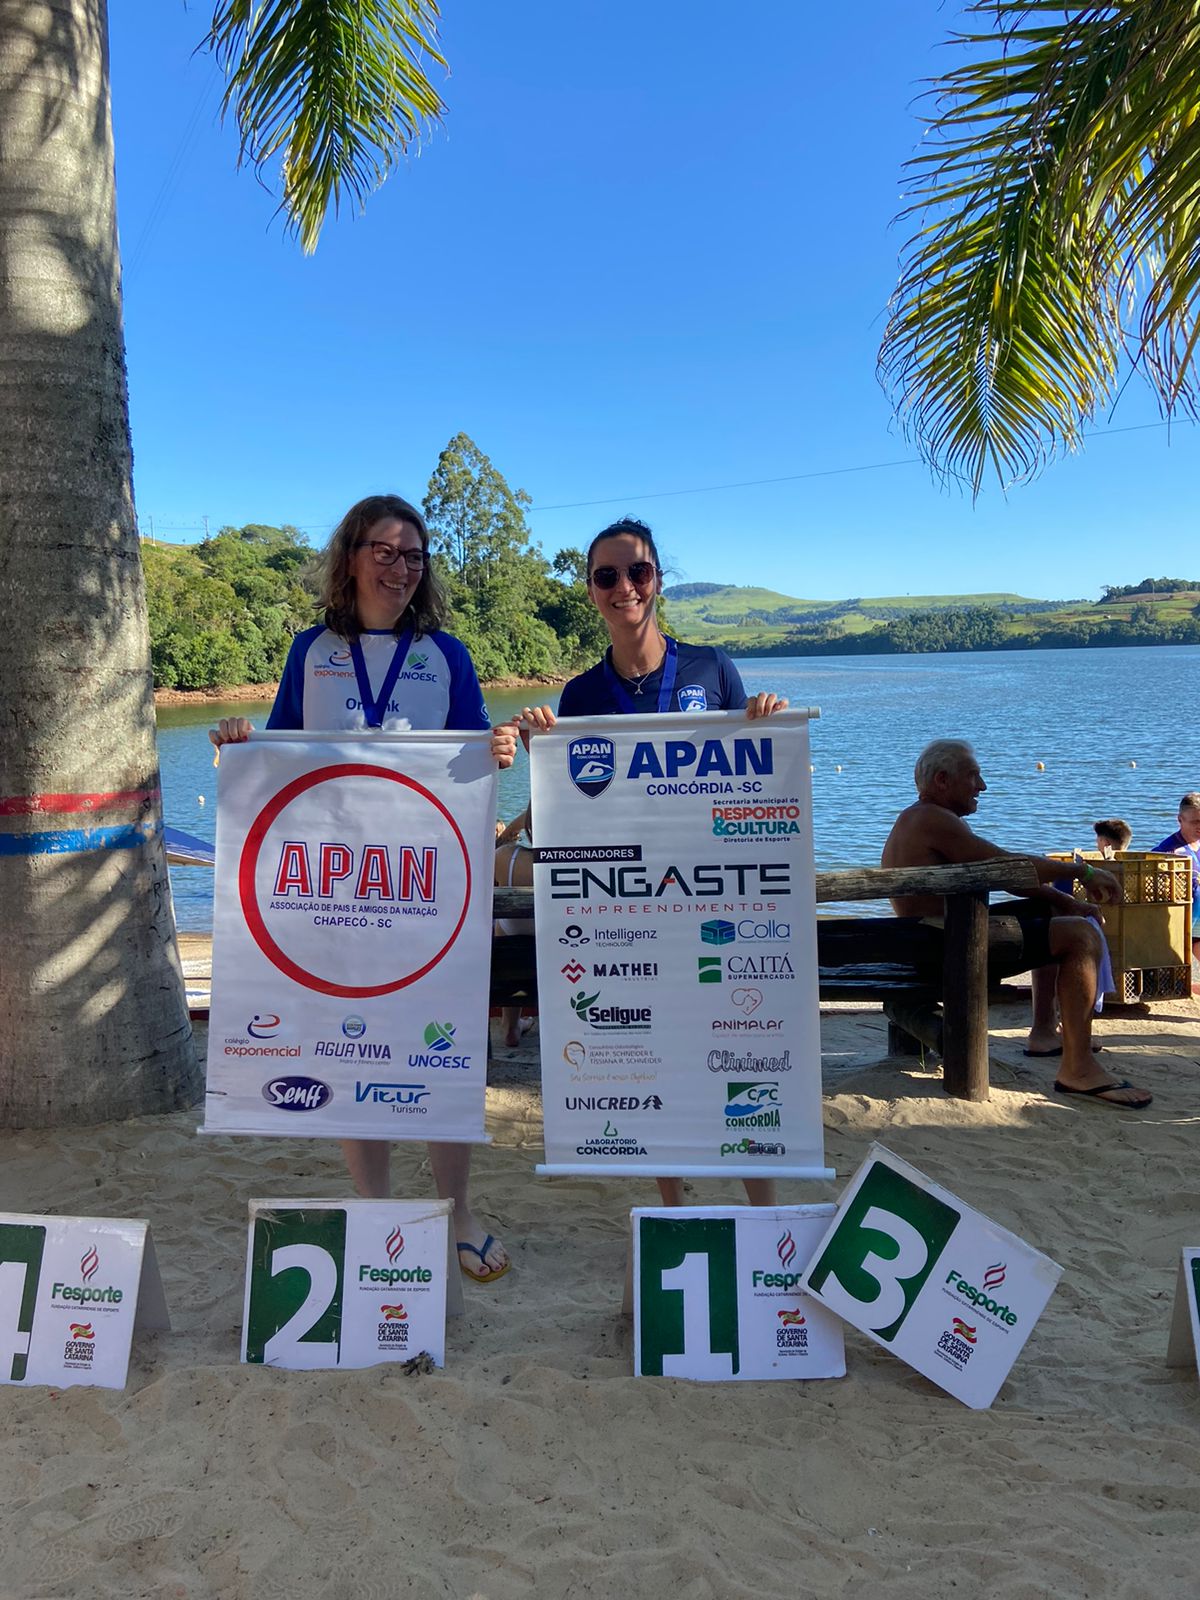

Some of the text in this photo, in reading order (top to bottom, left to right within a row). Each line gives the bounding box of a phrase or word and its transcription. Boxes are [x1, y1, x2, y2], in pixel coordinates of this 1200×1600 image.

[681, 688, 704, 698] APAN
[572, 743, 612, 755] APAN
[627, 738, 774, 779] APAN
[646, 780, 734, 796] CONCÓRDIA
[712, 805, 800, 820] DESPORTO
[540, 848, 634, 860] PATROCINADORES
[273, 841, 438, 902] APAN
[551, 864, 791, 899] ENGASTE
[270, 901, 438, 917] ASSOCIAÇÃO DE PAIS E AMIGOS DA NATAÇÃO
[566, 902, 776, 916] EMPREENDIMENTOS
[314, 915, 368, 928] CHAPECÓ
[377, 918, 392, 928] SC
[738, 920, 790, 938] Colla
[594, 928, 658, 942] Intelligenz
[594, 963, 658, 977] MATHEI
[728, 952, 794, 974] CAITÁ
[589, 1006, 652, 1024] Seligue
[224, 1045, 301, 1058] exponencial
[314, 1041, 392, 1059] AGUA VIVA
[408, 1055, 472, 1069] UNOESC
[707, 1049, 792, 1073] Clinimed
[266, 1081, 324, 1108] Senff
[566, 1096, 640, 1110] UNICRED
[392, 1104, 428, 1114] Turismo
[726, 1108, 780, 1128] CONCÓRDIA
[576, 1146, 648, 1156] CONCÓRDIA
[358, 1264, 432, 1286] Fesporte
[819, 1206, 928, 1330] 3
[52, 1282, 123, 1306] Fesporte
[946, 1270, 1018, 1326] Fesporte
[264, 1244, 339, 1369] 2
[661, 1252, 733, 1379] 1
[66, 1340, 96, 1348] GOVERNO
[940, 1336, 970, 1360] DE SANTA
[943, 1330, 974, 1354] GOVERNO
[64, 1353, 94, 1362] CATARINA
[937, 1341, 968, 1364] CATARINA
